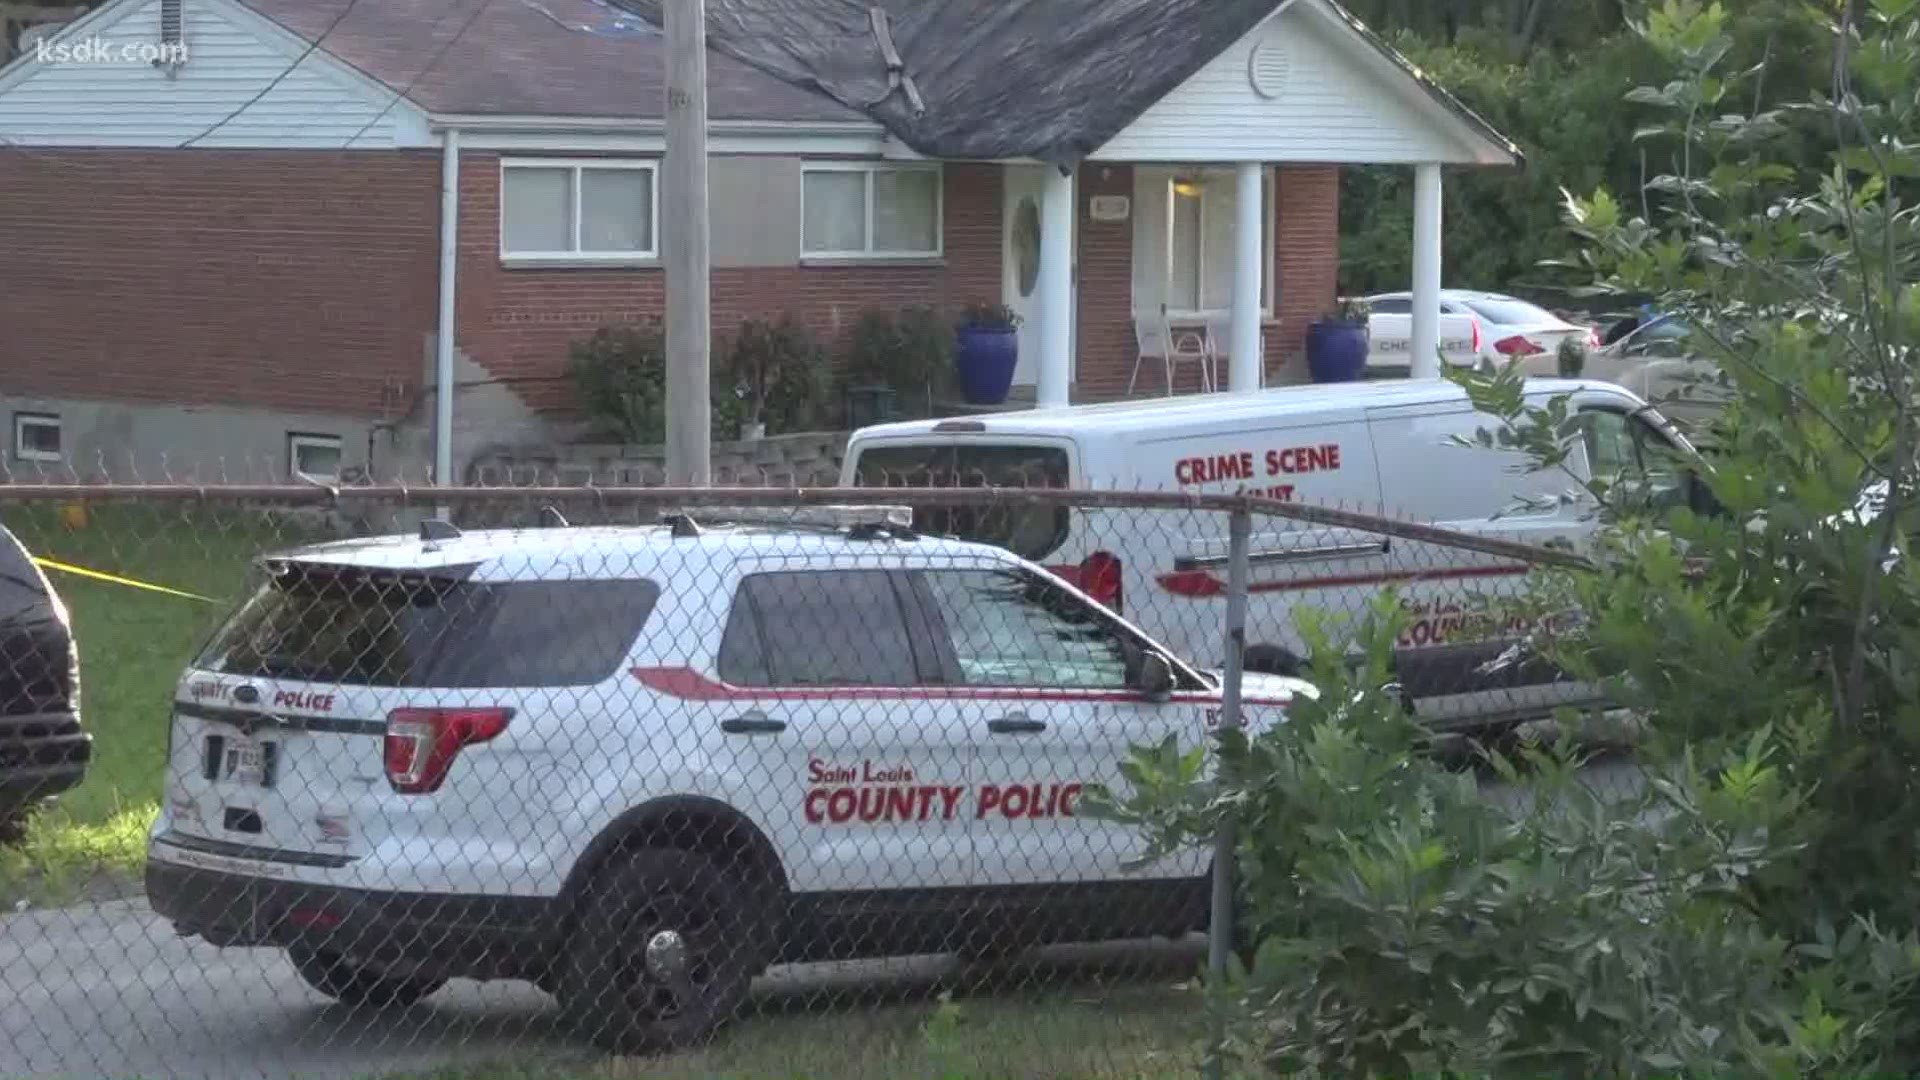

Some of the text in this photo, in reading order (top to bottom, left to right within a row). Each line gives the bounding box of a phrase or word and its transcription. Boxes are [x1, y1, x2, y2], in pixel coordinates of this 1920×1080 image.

[1175, 444, 1341, 485] CRIME SCENE
[274, 690, 335, 712] POLICE
[808, 758, 912, 783] Saint Louis
[804, 783, 1082, 823] COUNTY POLIC
